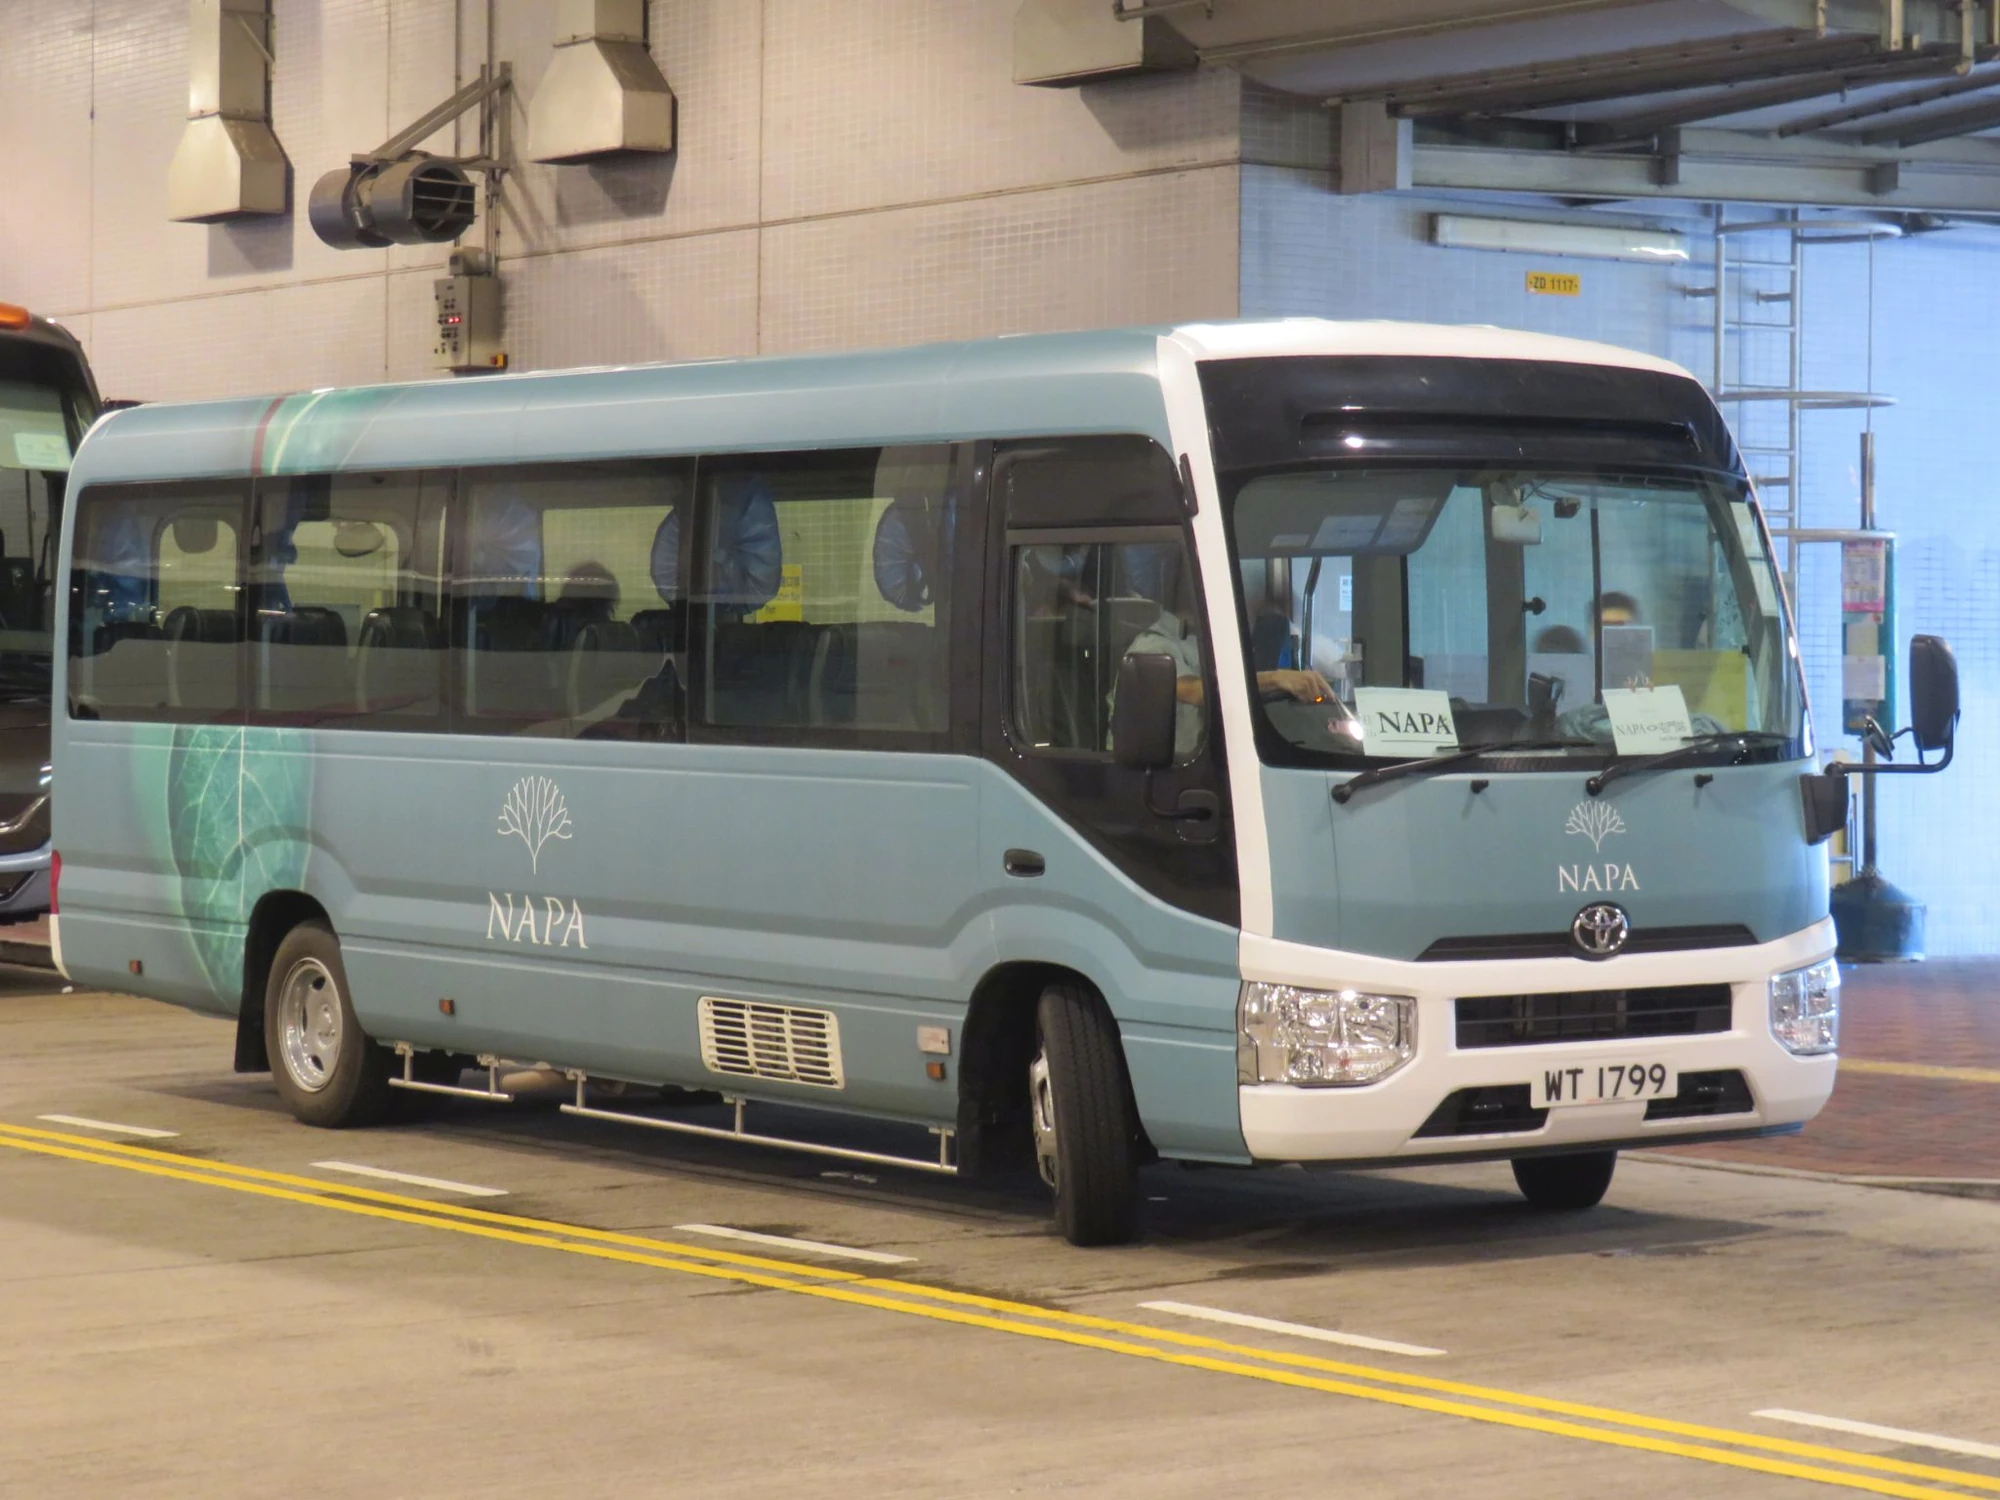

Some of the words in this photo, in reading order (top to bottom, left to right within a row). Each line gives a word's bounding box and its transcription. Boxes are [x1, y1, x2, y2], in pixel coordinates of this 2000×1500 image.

[1550, 278, 1574, 292] 1117
[1376, 711, 1454, 735] NAPA
[1558, 863, 1640, 892] NAPA
[485, 890, 589, 949] NAPA
[1545, 1067, 1584, 1101] WT
[1598, 1063, 1666, 1098] 1799
